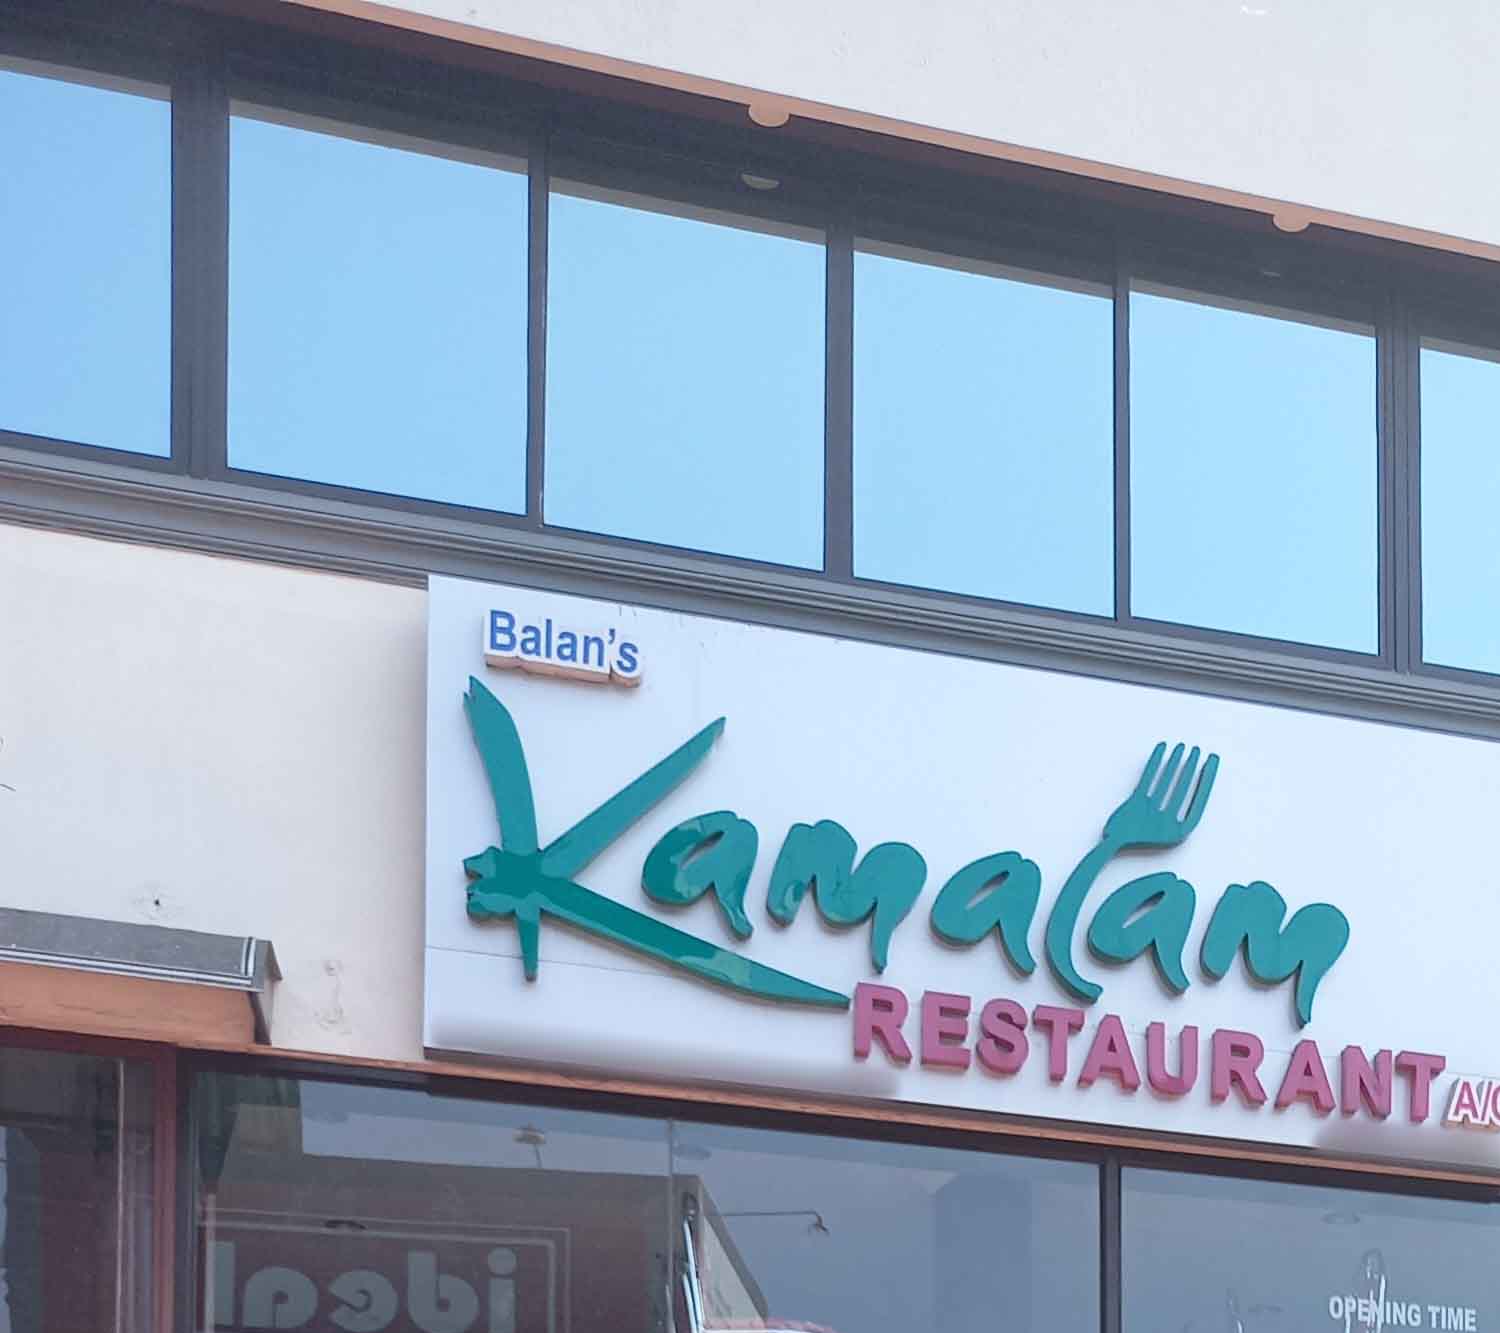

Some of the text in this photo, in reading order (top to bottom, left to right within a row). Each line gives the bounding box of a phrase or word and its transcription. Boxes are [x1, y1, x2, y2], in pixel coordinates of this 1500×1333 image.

[488, 609, 640, 674] Balan's
[462, 675, 1350, 1030] Kamalam
[852, 981, 1447, 1123] RESTAURANT
[1329, 1295, 1478, 1332] OPENING TIME
